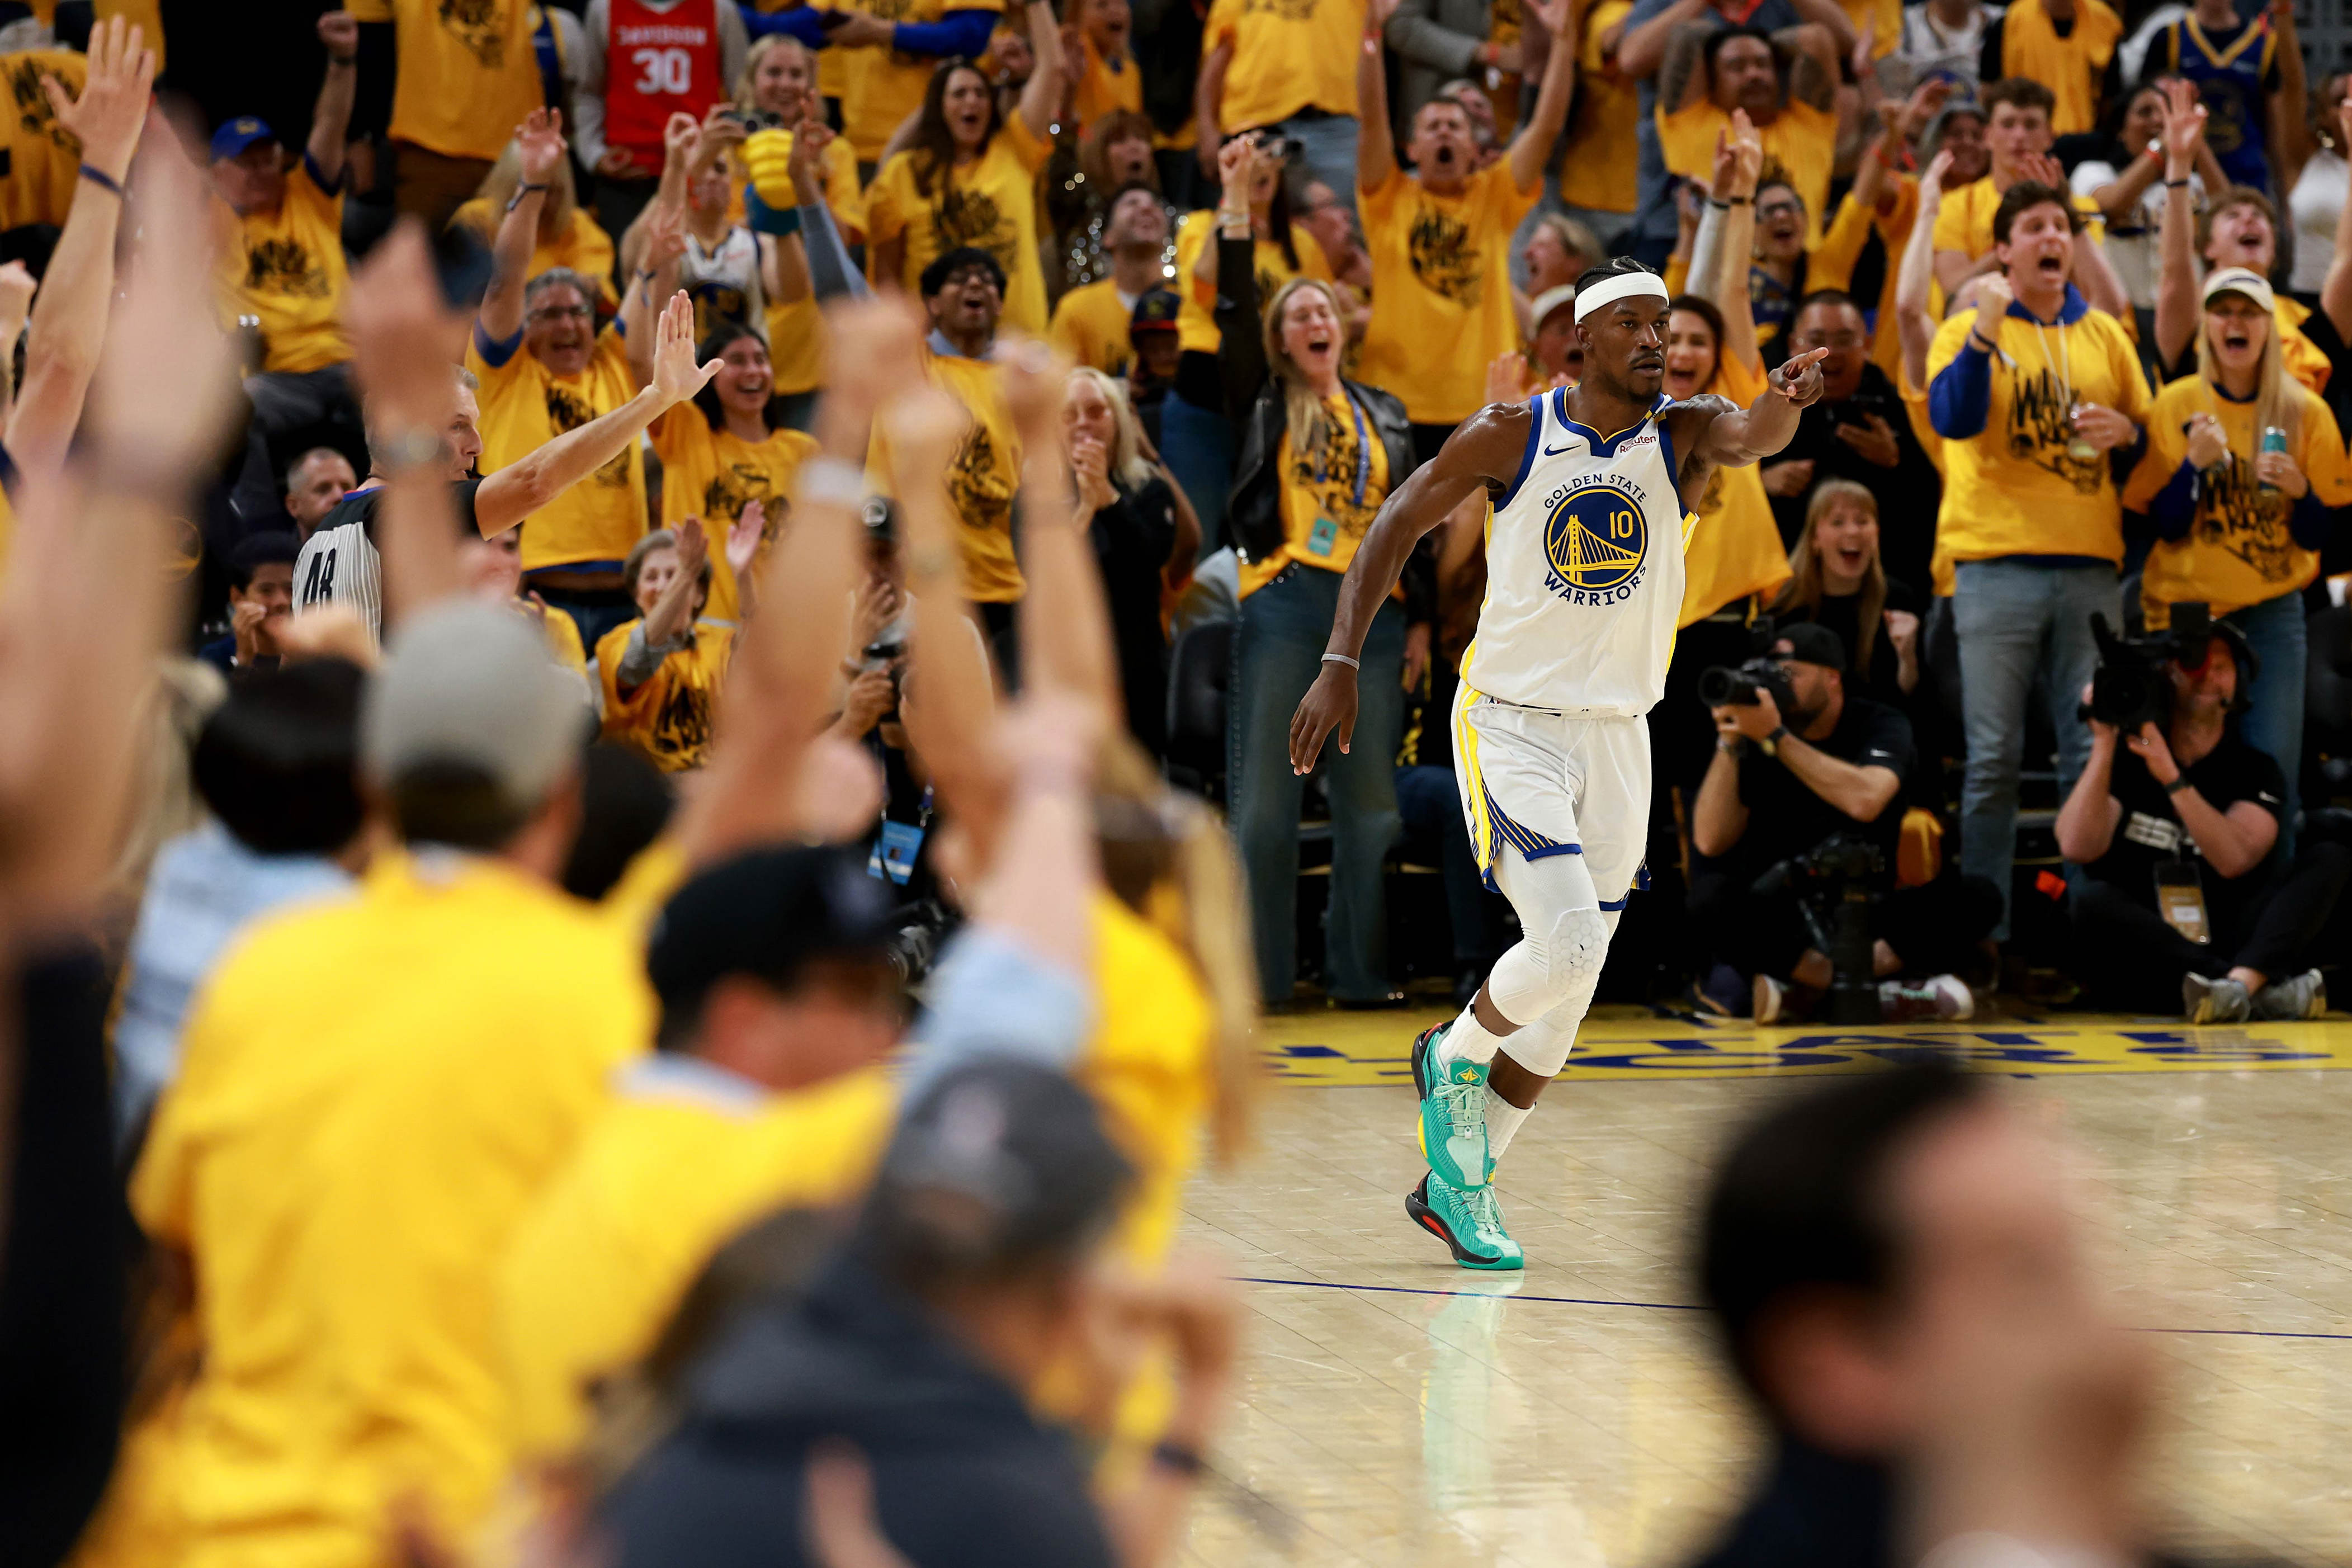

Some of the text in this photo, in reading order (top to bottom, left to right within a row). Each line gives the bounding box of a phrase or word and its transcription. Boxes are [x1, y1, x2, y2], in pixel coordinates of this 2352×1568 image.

[631, 47, 692, 95] 30
[1620, 436, 1656, 453] Ruten
[1545, 473, 1646, 509] GOLDEN STATE
[1609, 510, 1633, 539] 10
[1544, 565, 1646, 606] WARRIORS
